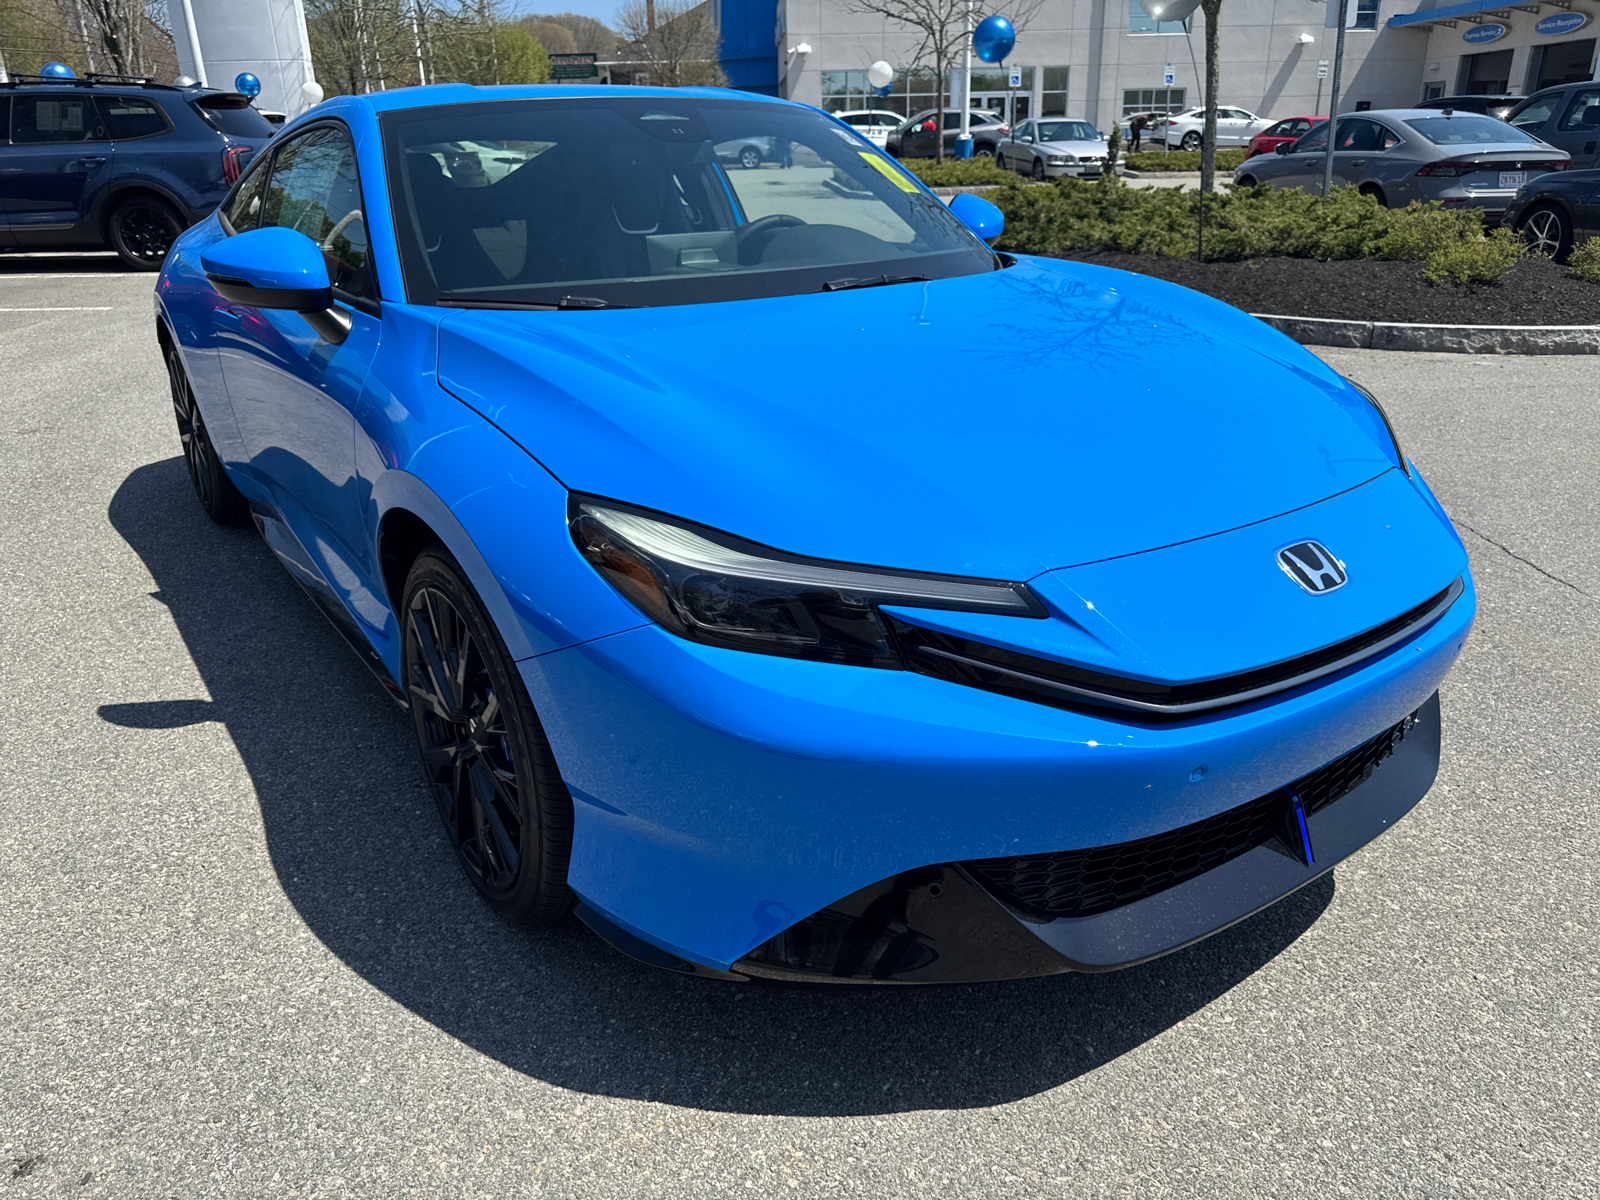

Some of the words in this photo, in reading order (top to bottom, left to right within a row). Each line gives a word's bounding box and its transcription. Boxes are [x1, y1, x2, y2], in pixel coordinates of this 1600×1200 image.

[1537, 21, 1556, 30] Service
[1556, 17, 1583, 27] Reception
[1464, 32, 1480, 40] Express
[1480, 29, 1496, 37] Service
